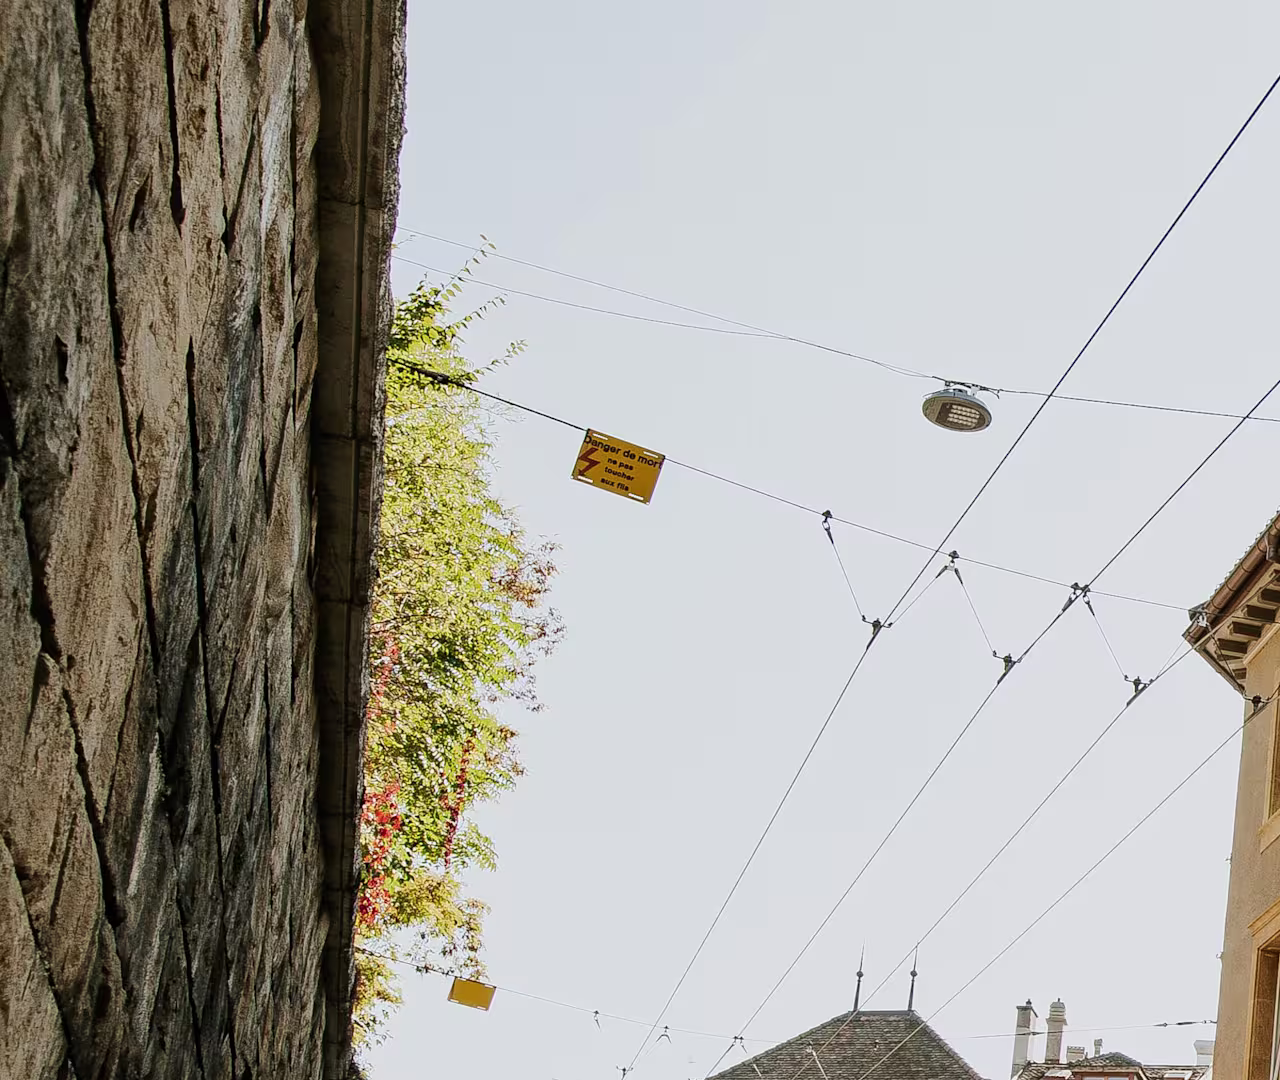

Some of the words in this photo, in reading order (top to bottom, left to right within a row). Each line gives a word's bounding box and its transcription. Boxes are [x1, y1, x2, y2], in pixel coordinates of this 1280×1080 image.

[584, 435, 621, 454] Danger
[623, 450, 636, 460] de
[638, 455, 663, 469] mort
[607, 457, 617, 465] ne
[618, 461, 634, 471] pas
[604, 466, 635, 481] toucher
[600, 477, 615, 486] aux
[616, 482, 630, 491] fils
